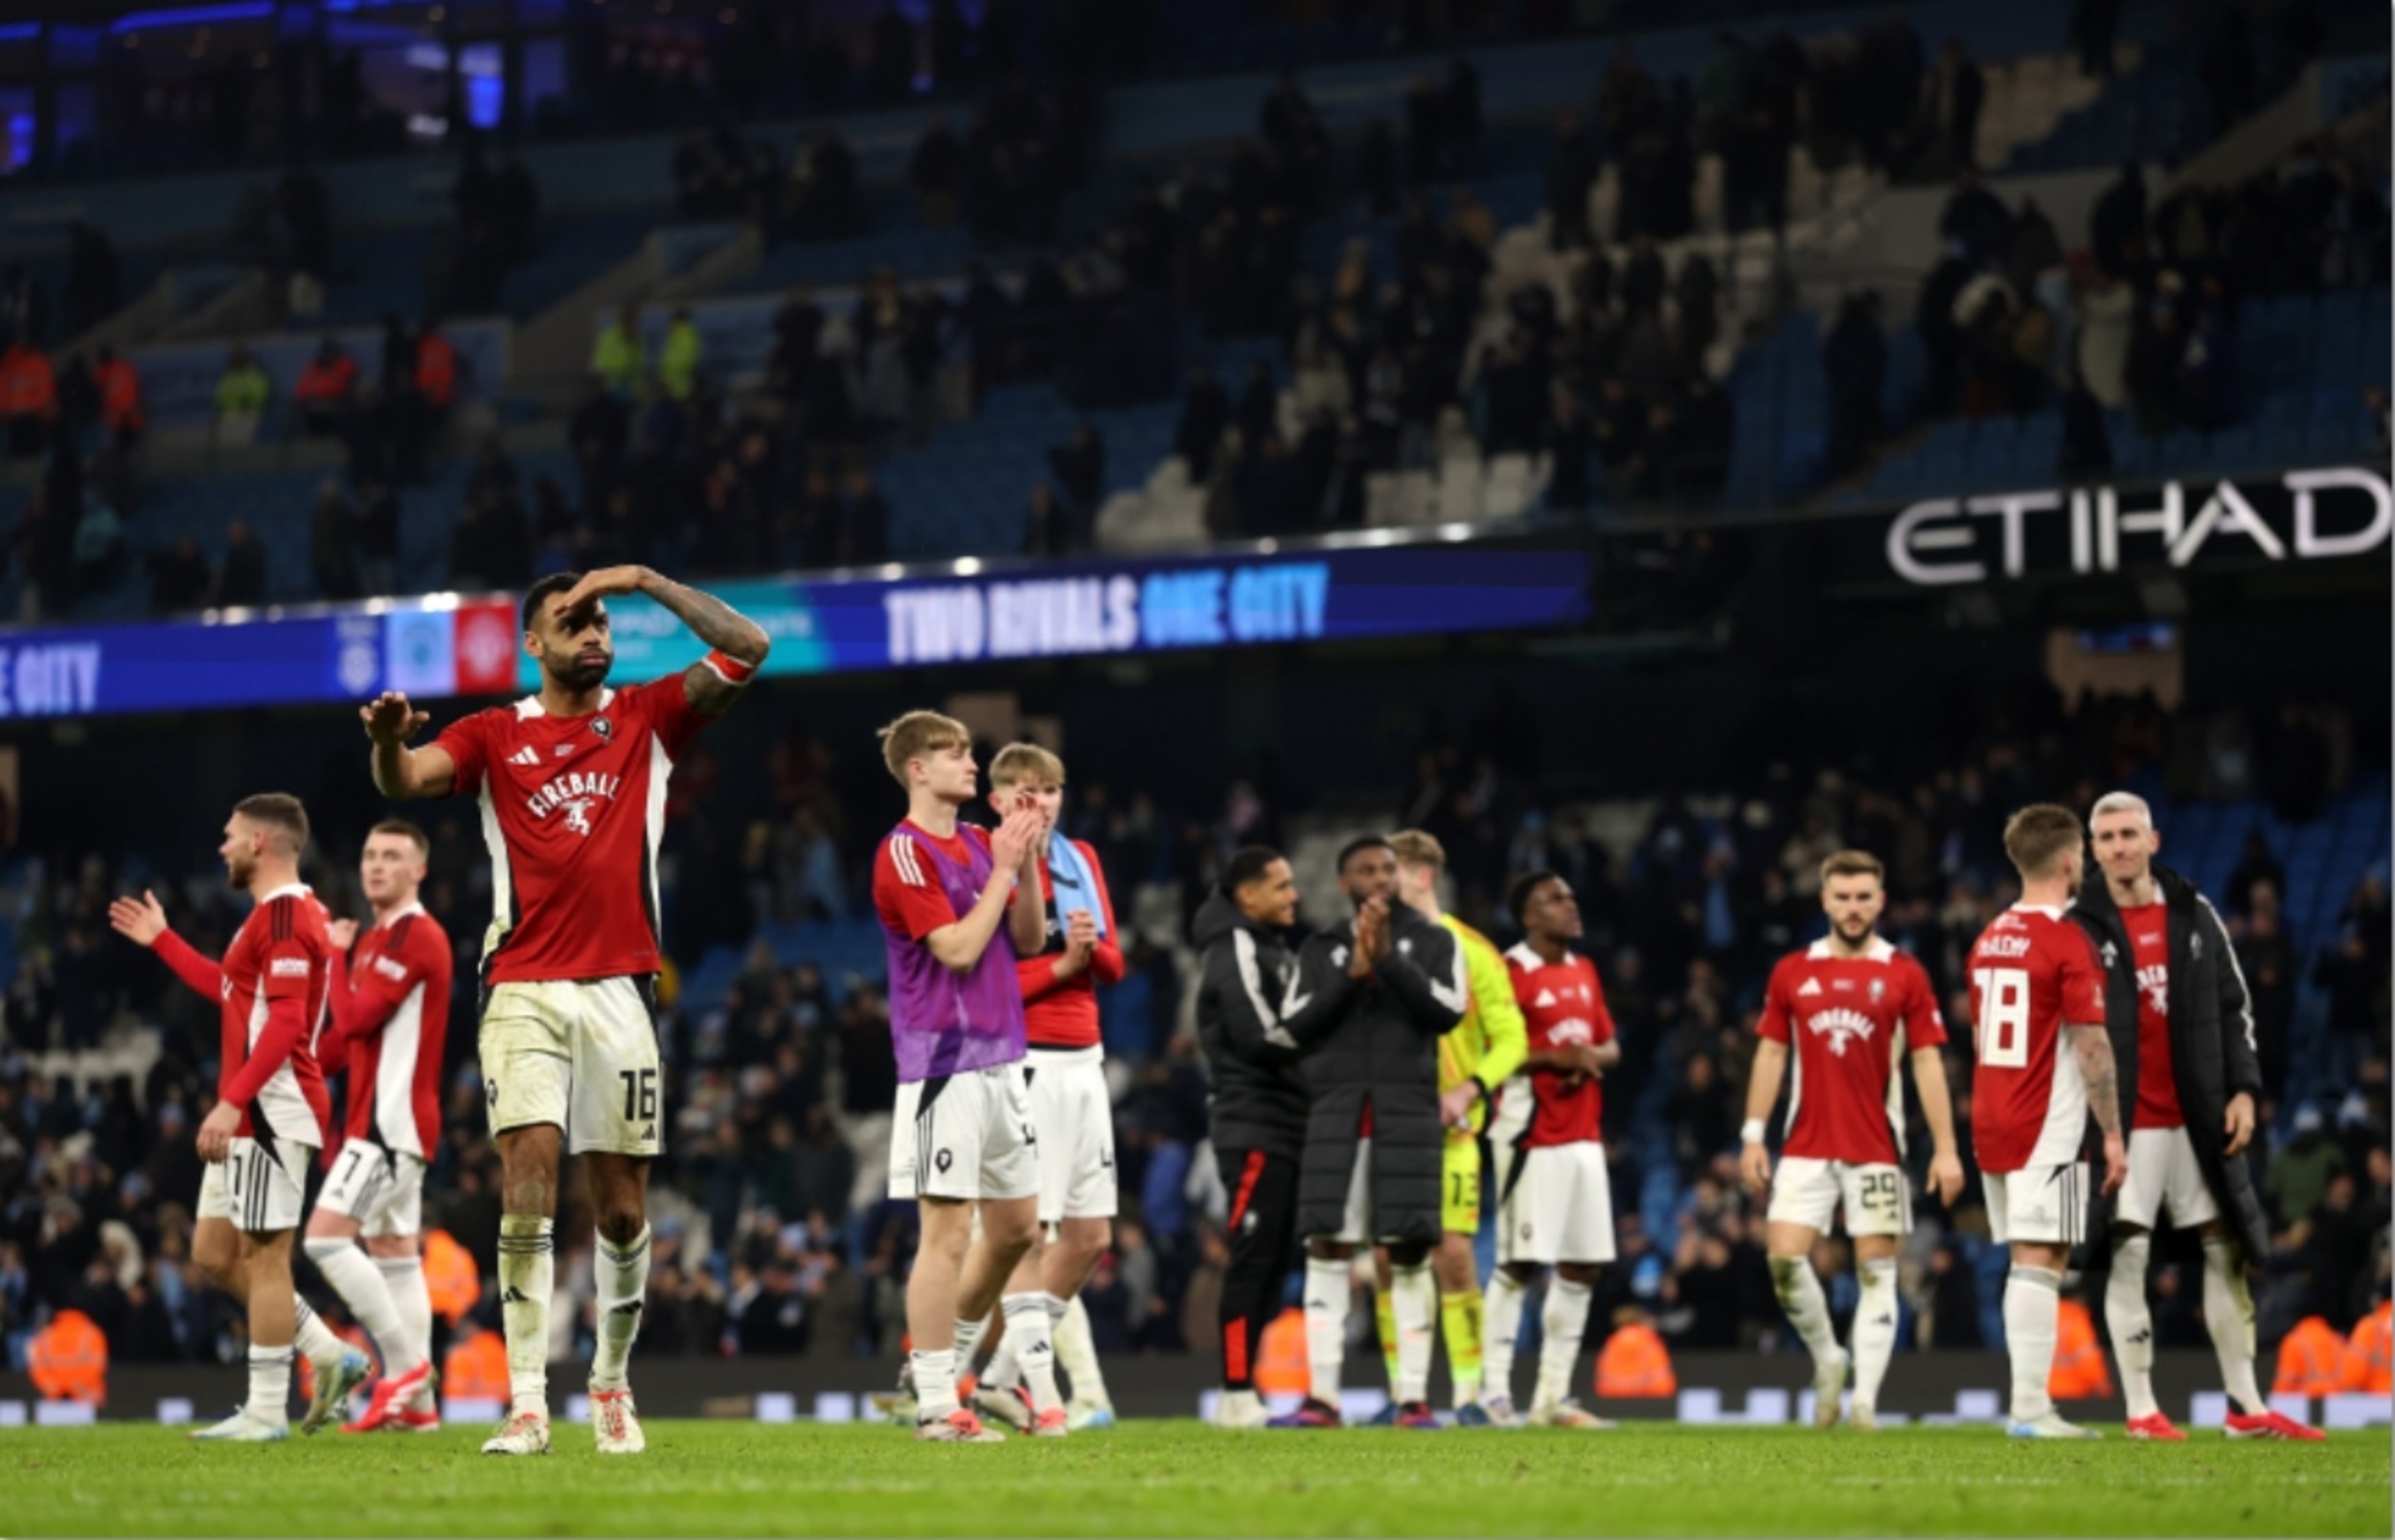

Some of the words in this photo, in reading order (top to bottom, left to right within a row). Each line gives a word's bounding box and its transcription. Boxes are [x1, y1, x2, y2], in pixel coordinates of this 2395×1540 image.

[1886, 467, 2391, 583] ETIHAD
[884, 586, 984, 664] TWO
[988, 573, 1139, 658] RIVALS
[1229, 560, 1329, 641] CITY
[14, 641, 101, 717] CITY
[527, 770, 621, 819] FIREBALL
[1973, 966, 2029, 1070] 18
[619, 1068, 656, 1121] 16
[1860, 1172, 1898, 1209] 29
